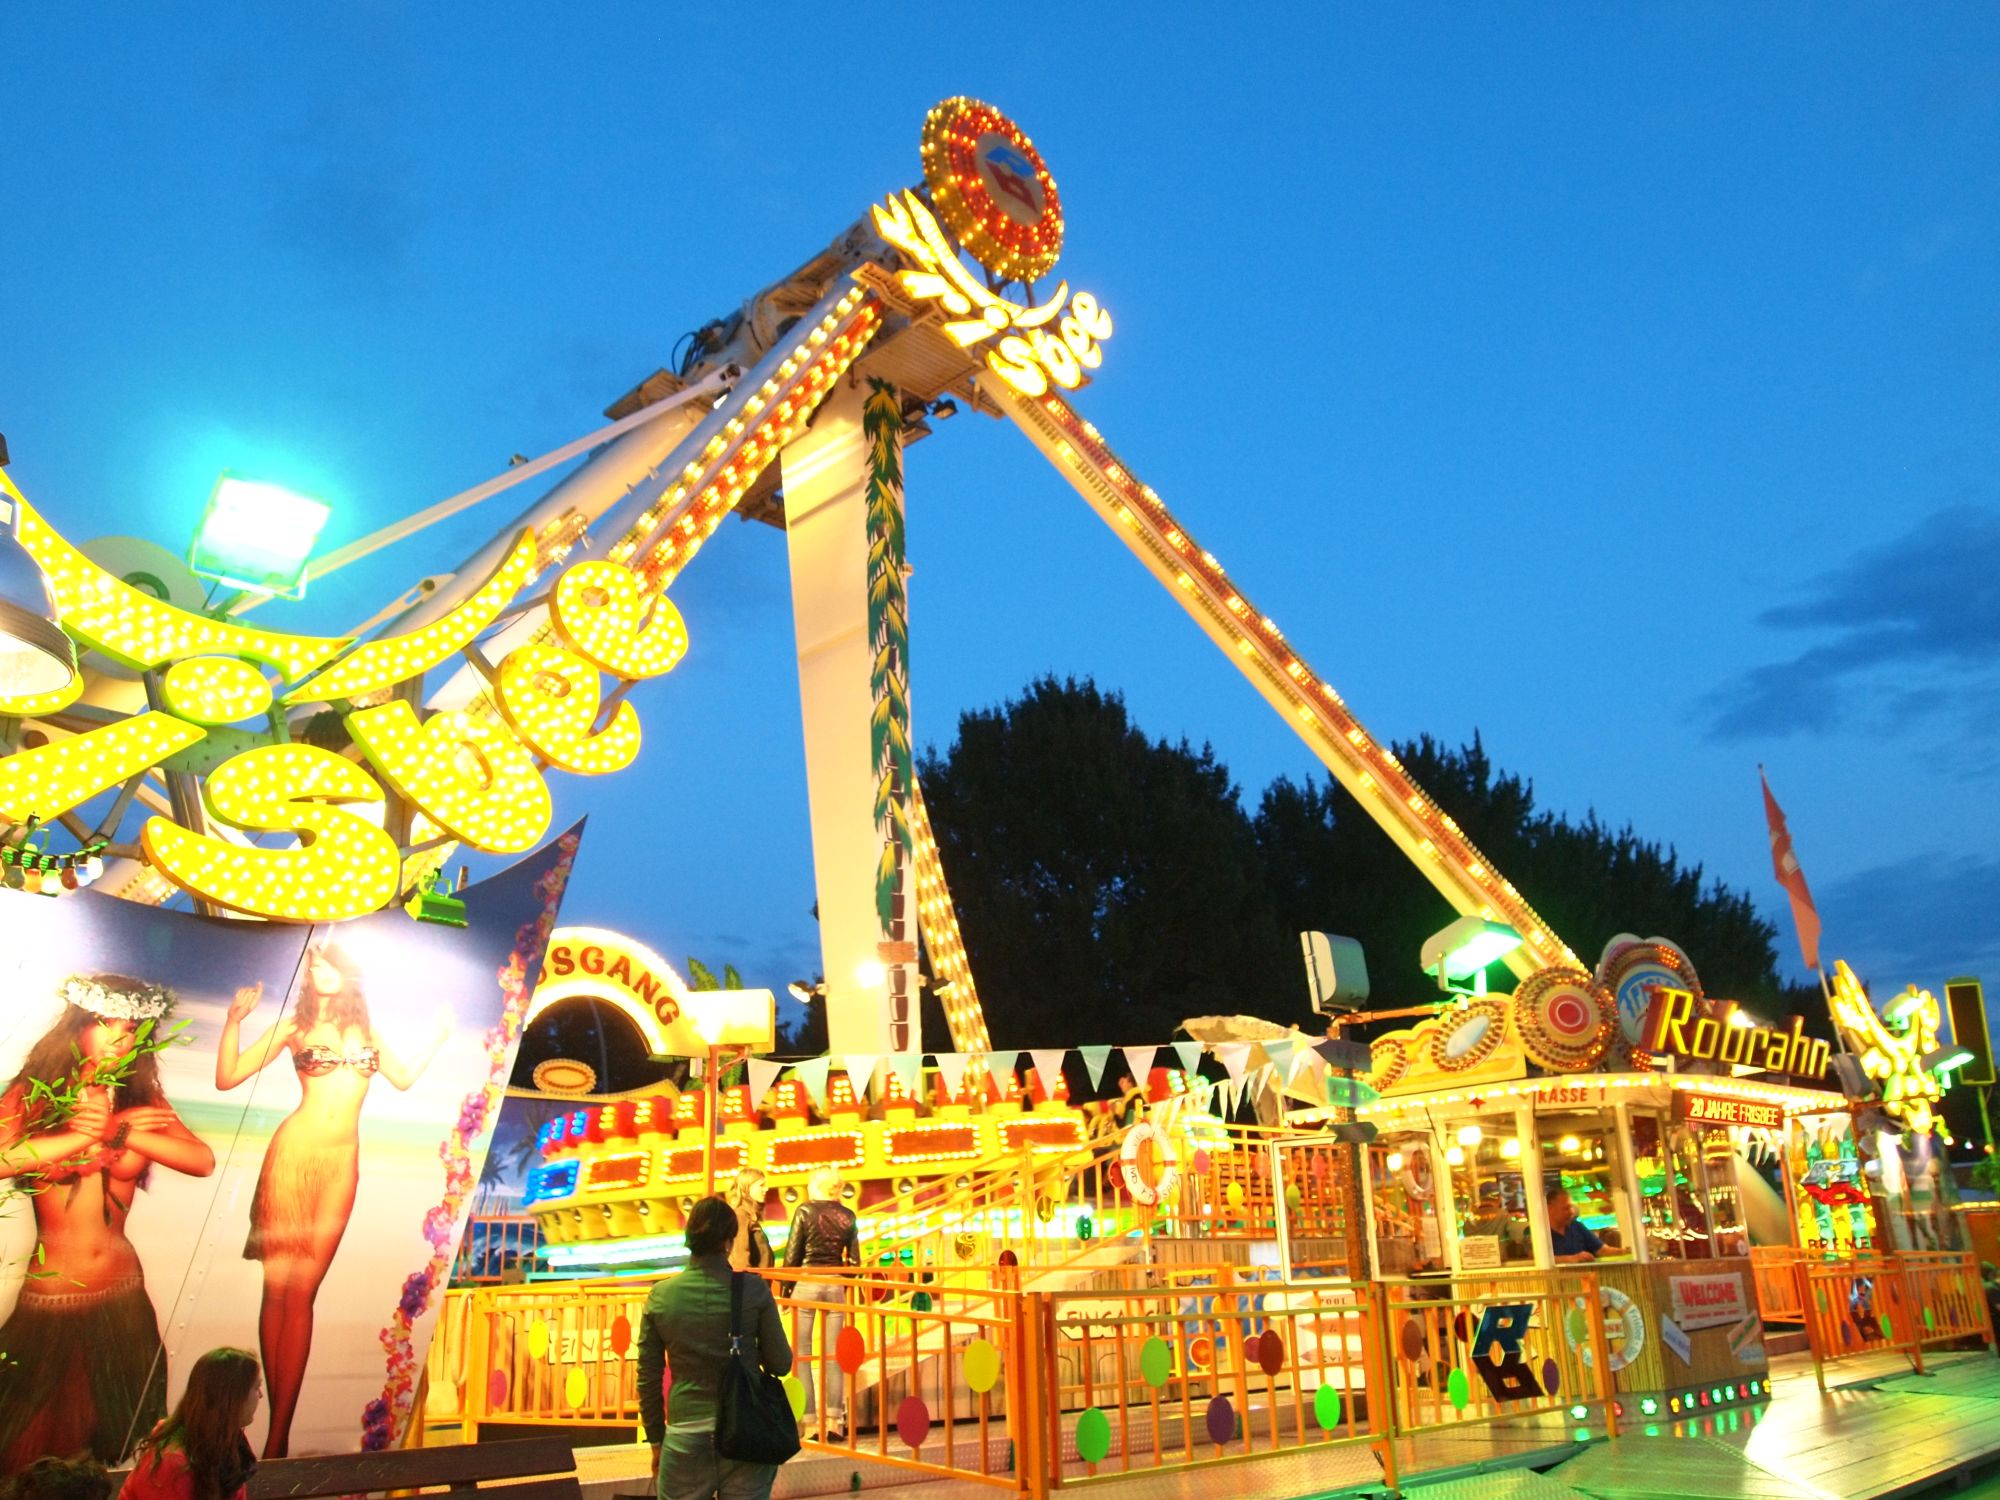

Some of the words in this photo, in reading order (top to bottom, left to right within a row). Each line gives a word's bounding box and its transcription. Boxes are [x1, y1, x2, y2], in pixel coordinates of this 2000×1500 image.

[1647, 985, 1831, 1079] Robrahn
[1538, 1087, 1587, 1104] KASSE
[1689, 1097, 1704, 1117] 20
[1705, 1099, 1738, 1120] JAHRE
[1738, 1104, 1779, 1126] FRISBEE
